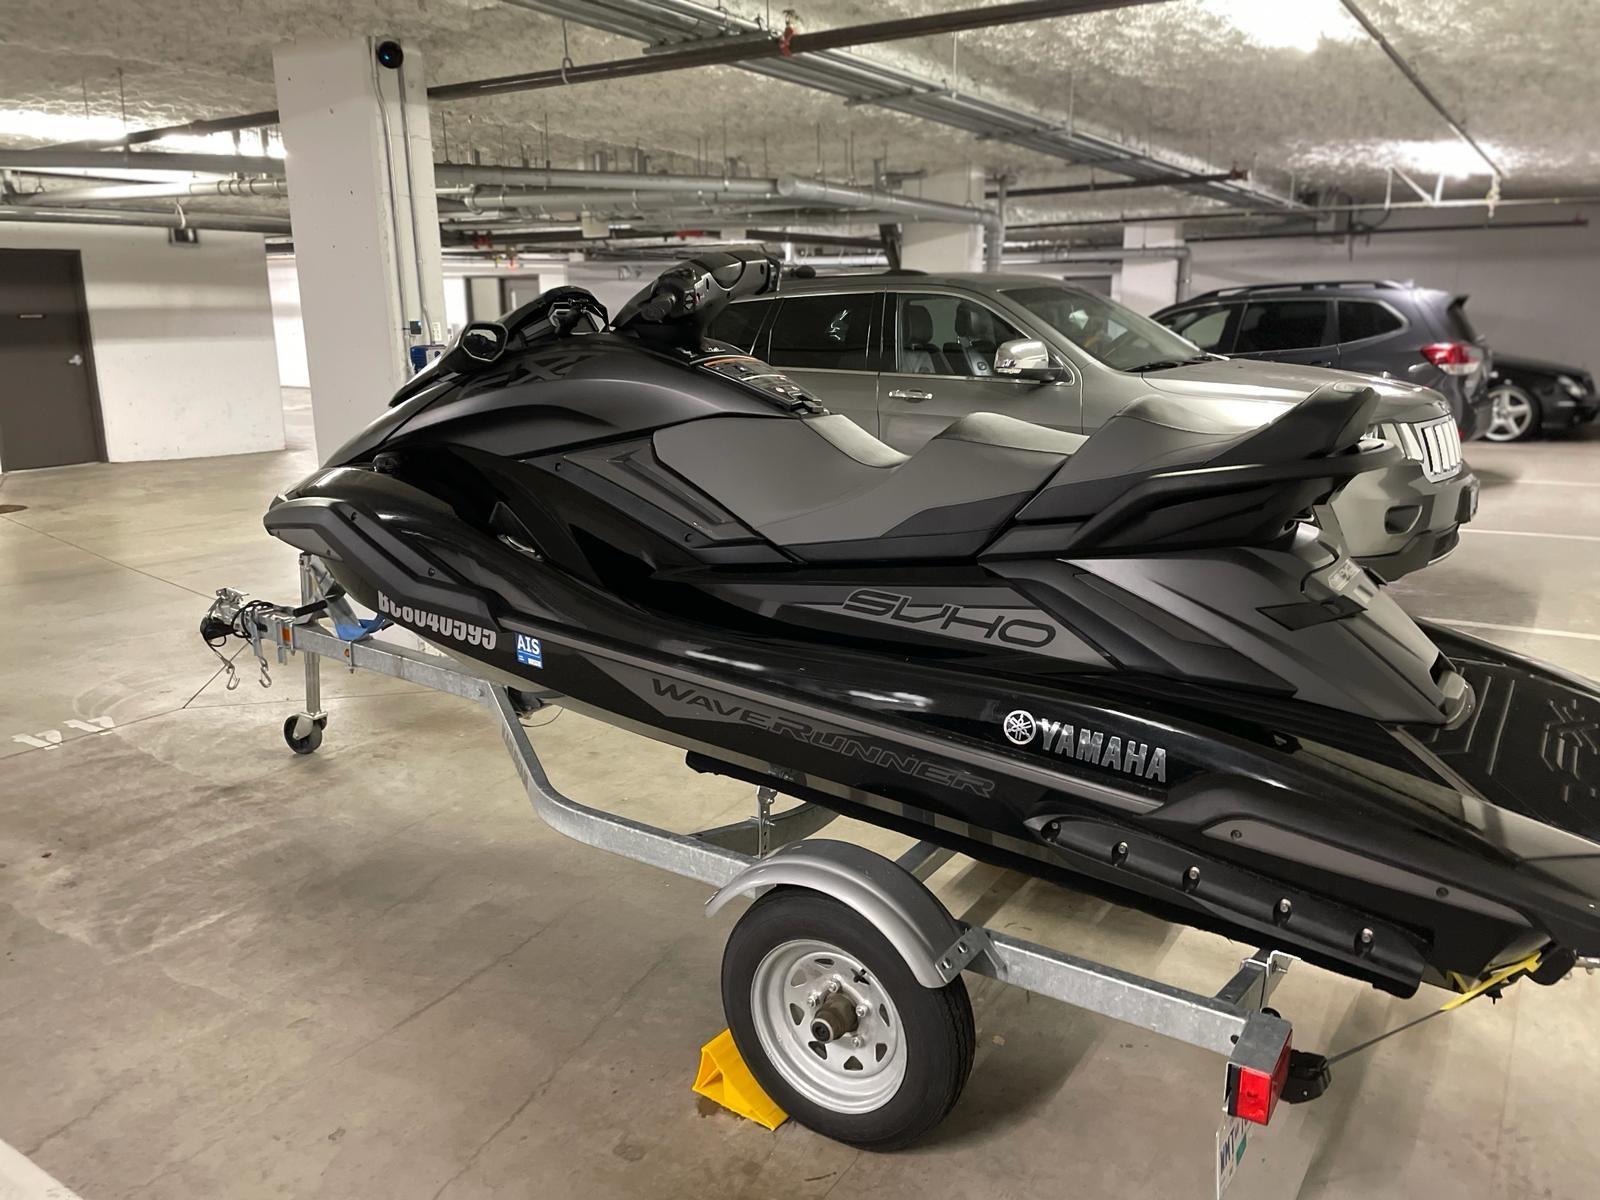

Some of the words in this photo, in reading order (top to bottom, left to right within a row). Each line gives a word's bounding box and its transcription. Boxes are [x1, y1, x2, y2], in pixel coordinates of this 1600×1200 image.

[517, 634, 540, 655] AIS
[842, 588, 1056, 648] SVHO
[1041, 718, 1166, 783] YAMAHA
